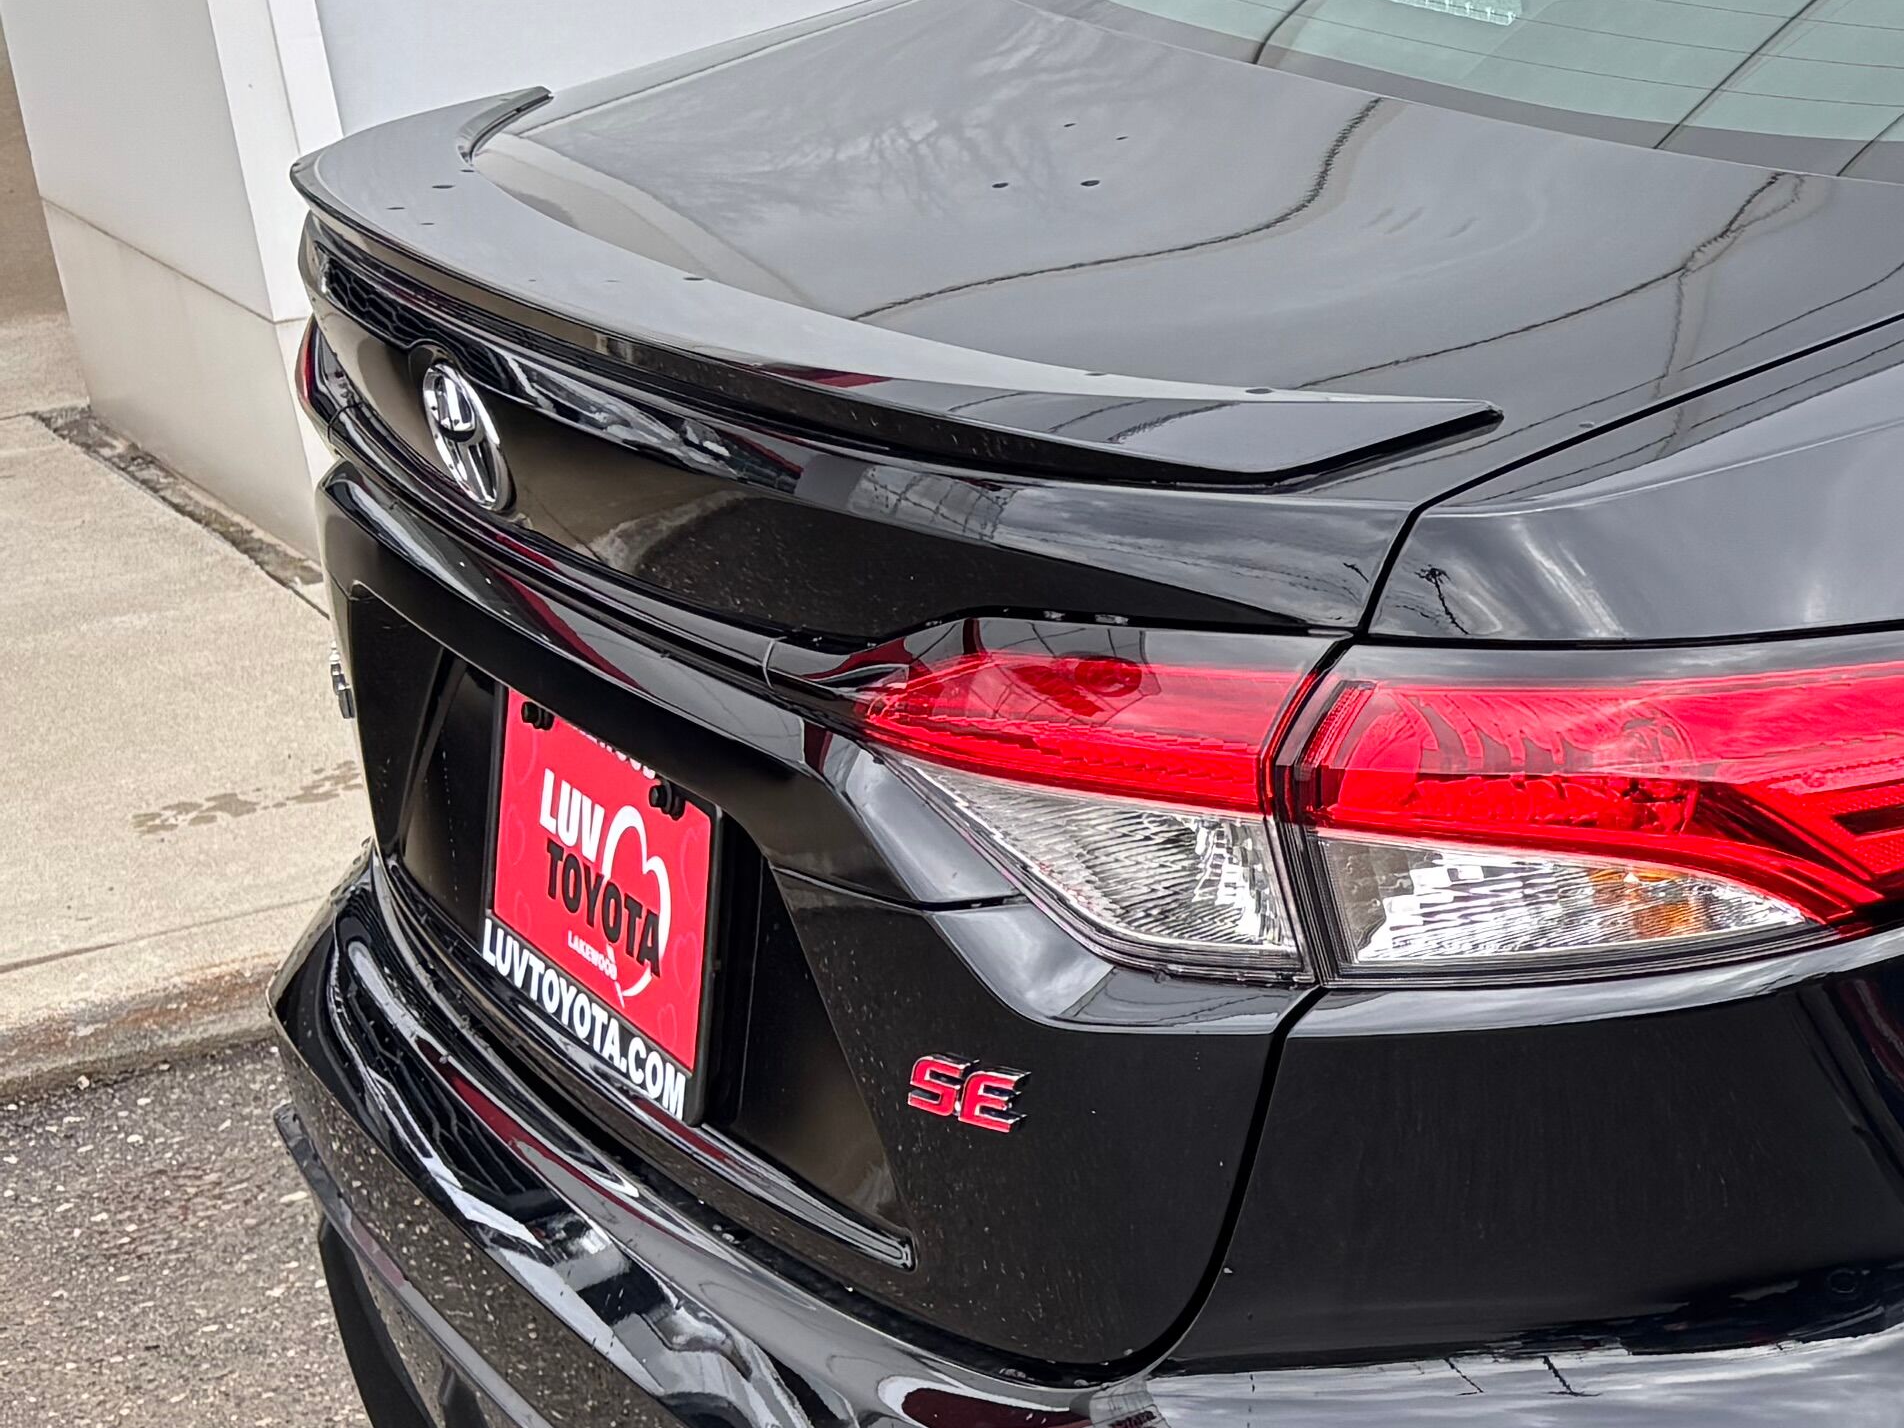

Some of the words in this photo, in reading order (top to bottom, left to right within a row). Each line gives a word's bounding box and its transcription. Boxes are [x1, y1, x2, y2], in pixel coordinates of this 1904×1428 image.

[539, 768, 605, 863] LUV
[547, 836, 660, 978] TOYOTA
[568, 930, 618, 981] LAKEWOOD
[482, 918, 686, 1121] LUVTOYOTA.COM
[907, 1051, 1030, 1134] SE
